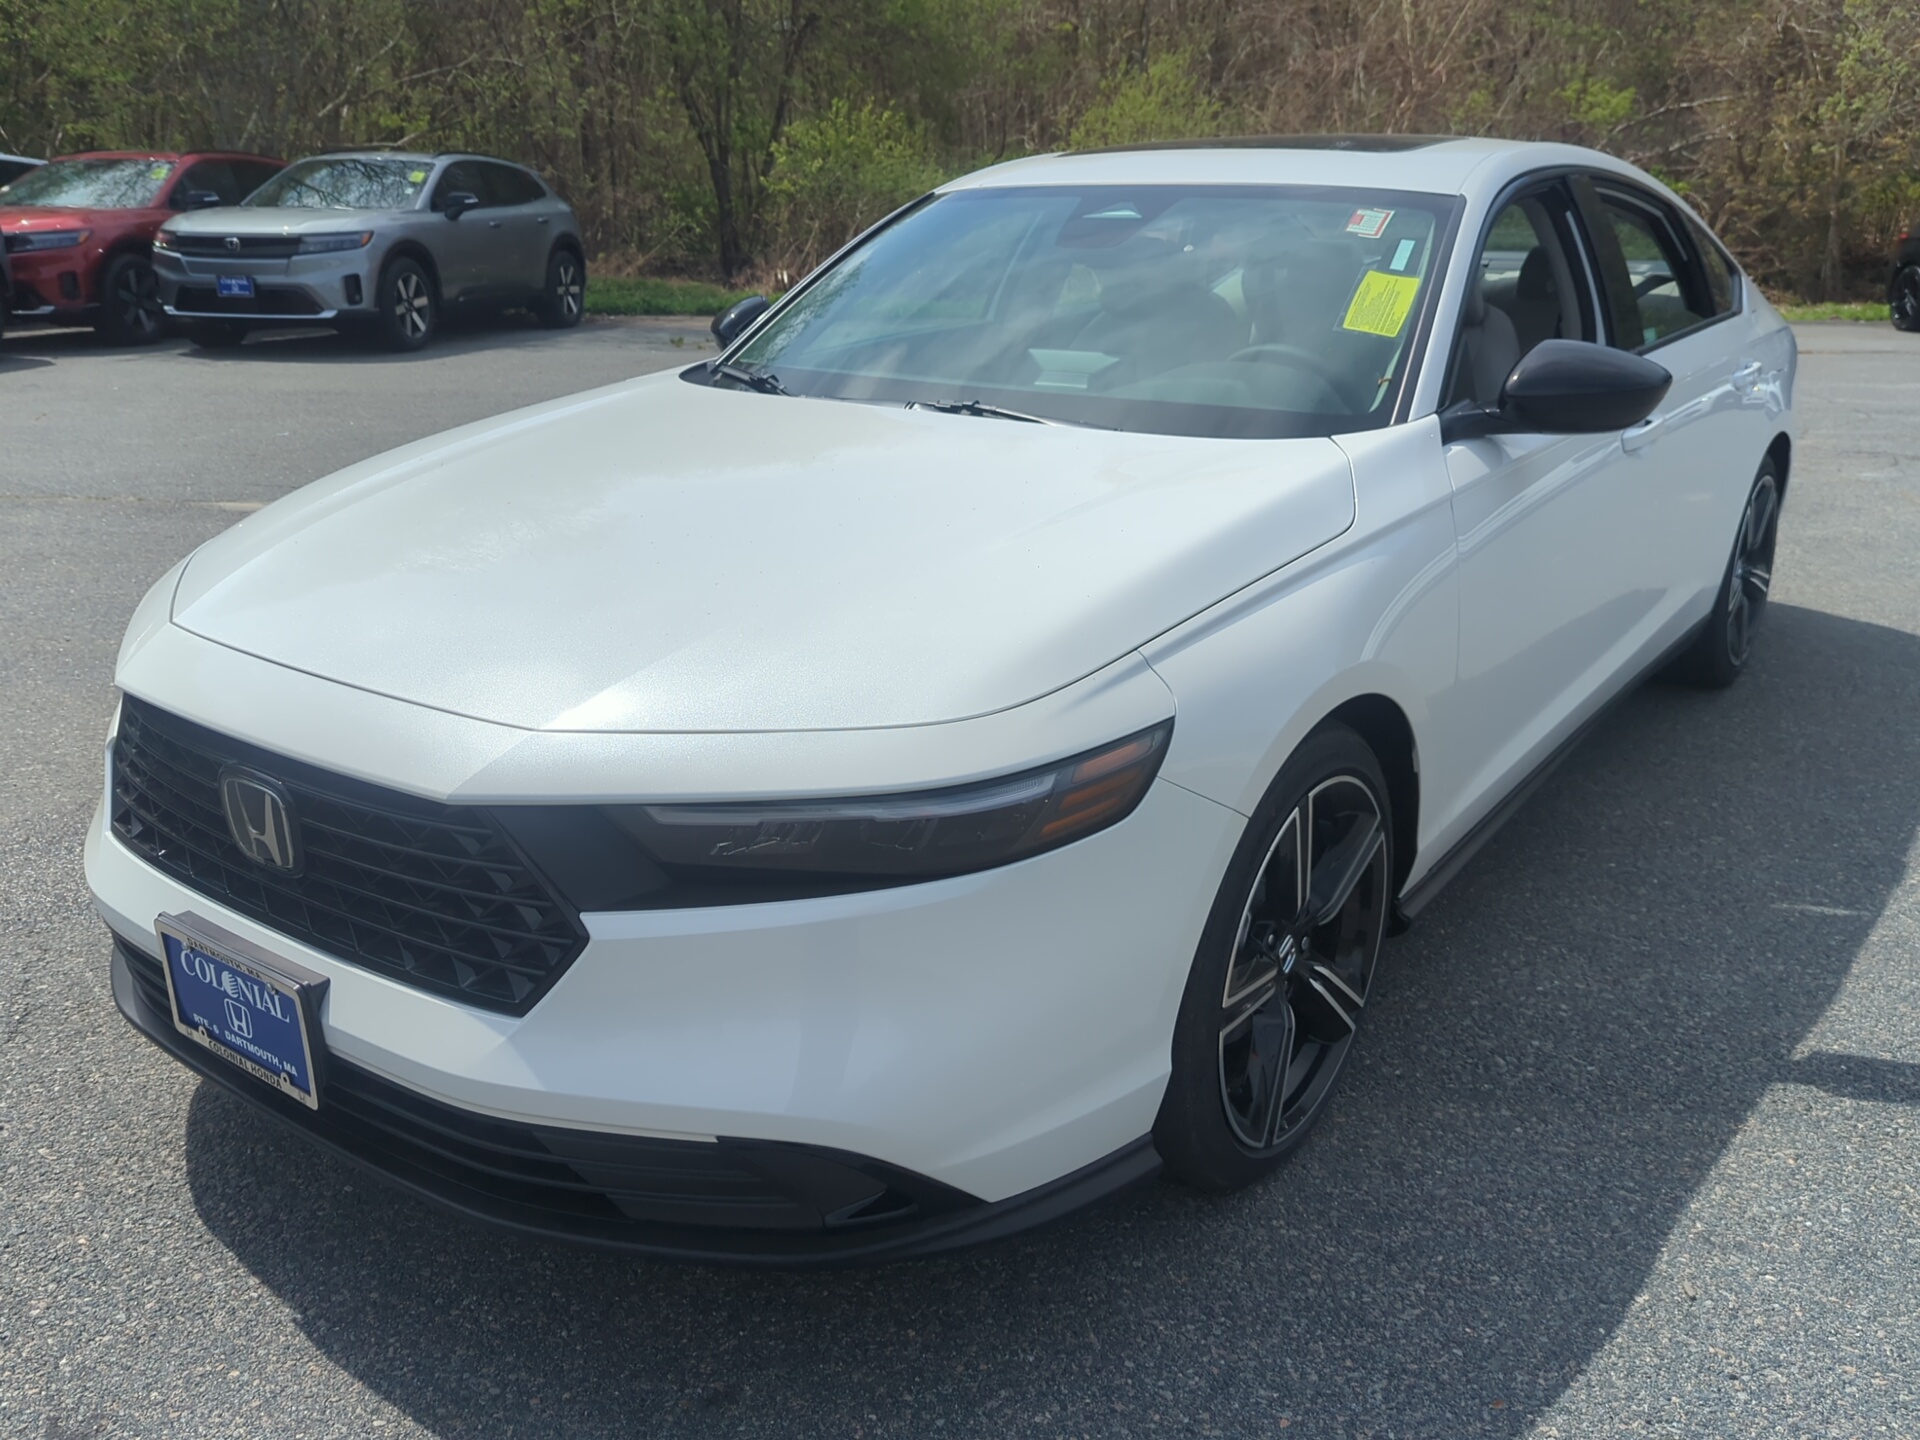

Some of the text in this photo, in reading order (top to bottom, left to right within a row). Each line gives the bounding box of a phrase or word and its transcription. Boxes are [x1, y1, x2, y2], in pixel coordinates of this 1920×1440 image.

[180, 949, 290, 1023] COLONIAL
[208, 1040, 282, 1089] COLONIAL HONDA
[224, 1030, 298, 1077] DARTMOUTH, MA
